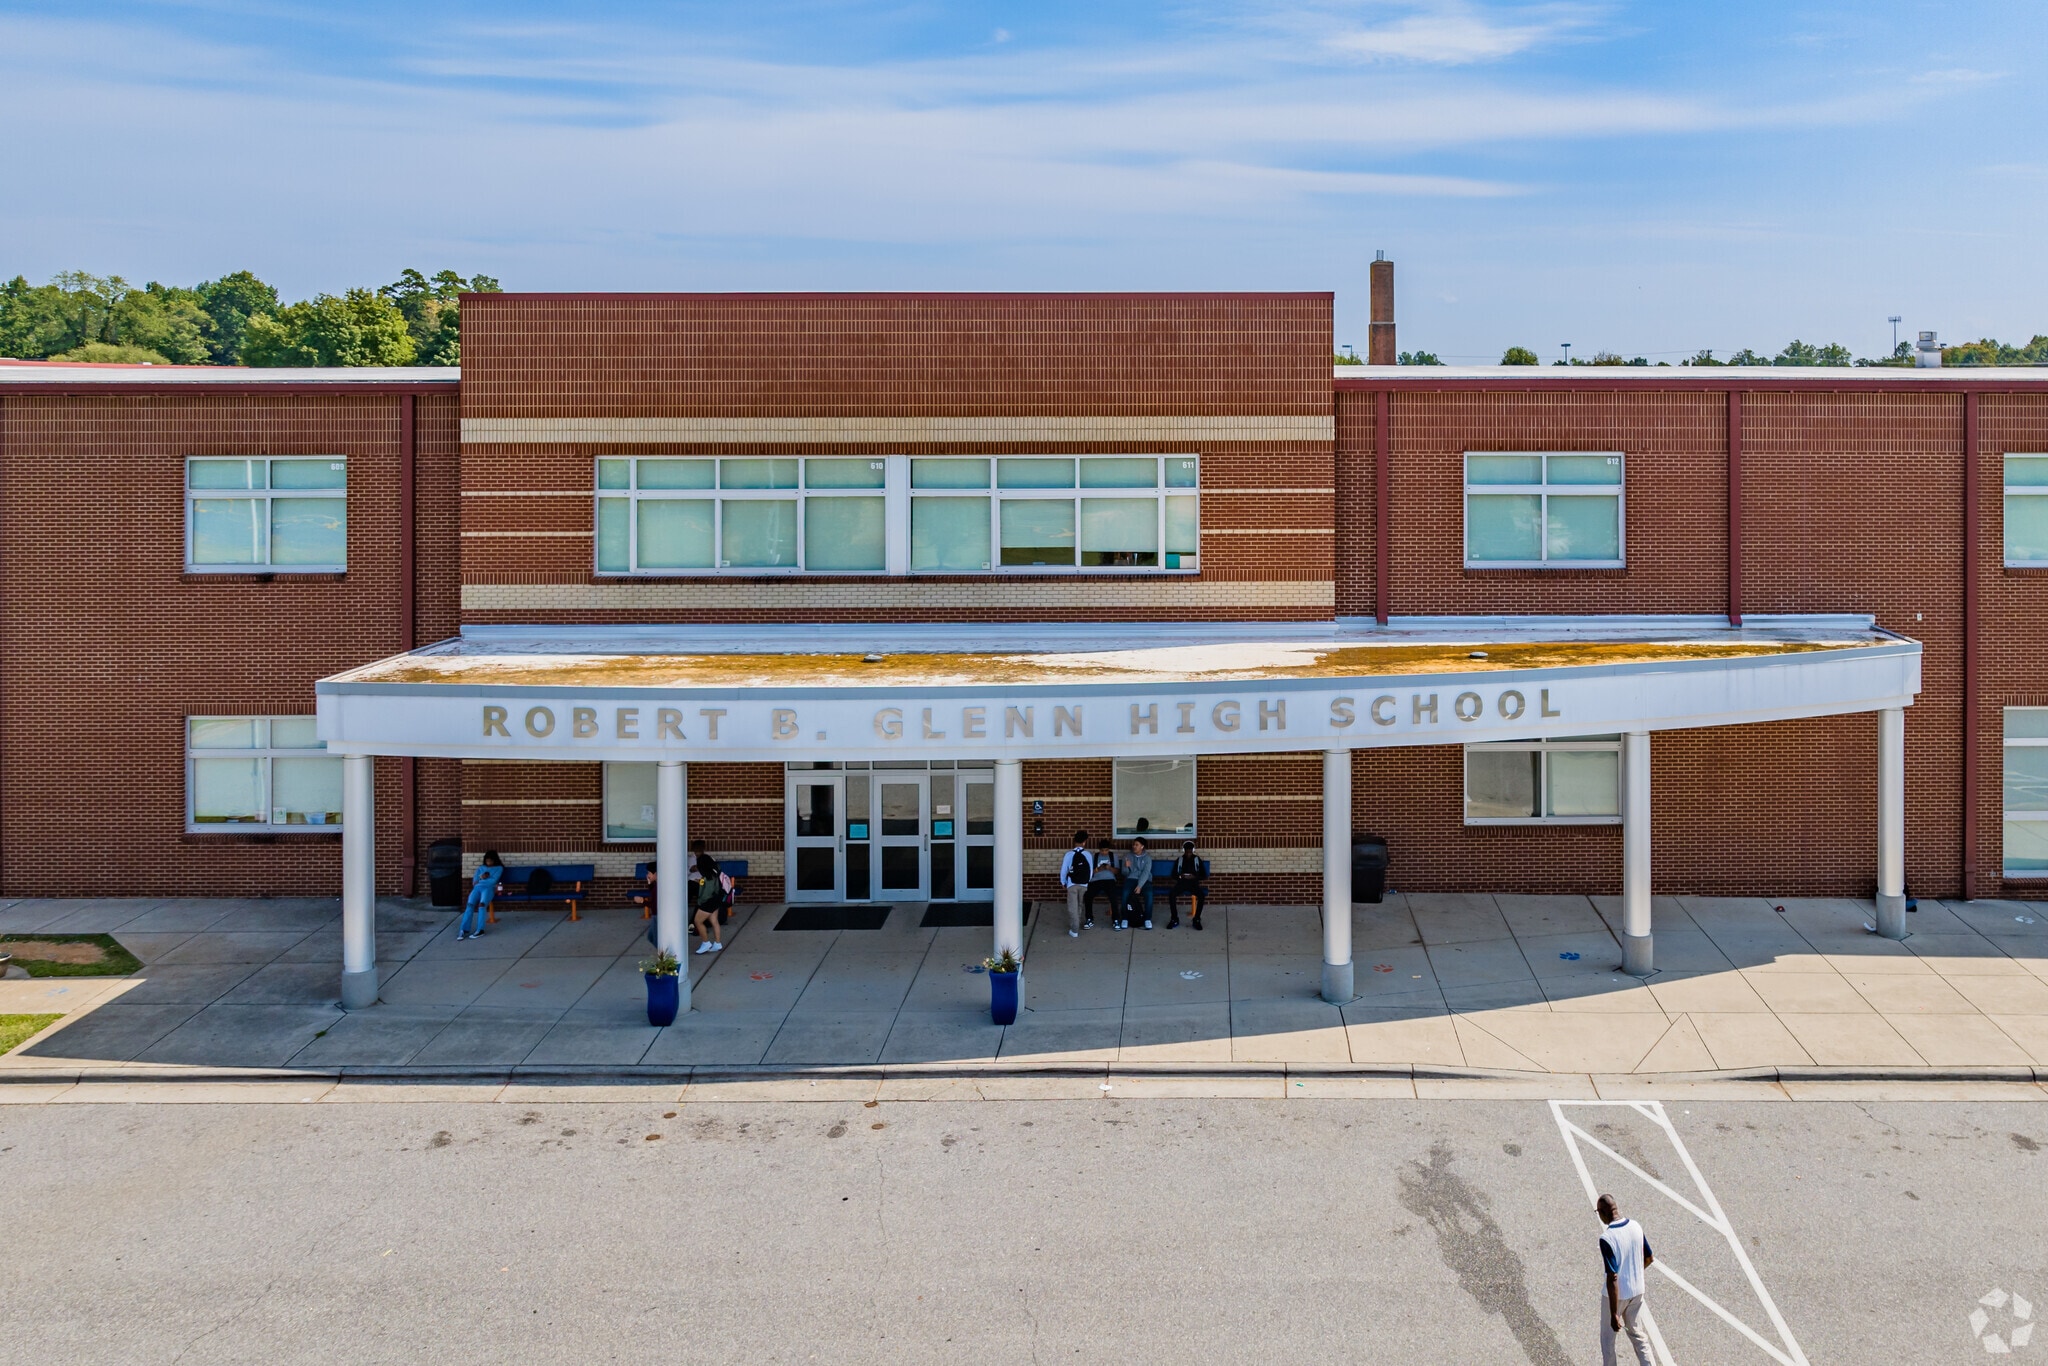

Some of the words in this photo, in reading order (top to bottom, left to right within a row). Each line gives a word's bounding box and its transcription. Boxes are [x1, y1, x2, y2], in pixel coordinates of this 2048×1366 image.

[482, 705, 727, 740] ROBERT
[772, 708, 827, 741] B.
[873, 705, 1084, 739] GLENN
[1130, 699, 1287, 735] HIGH
[1330, 689, 1561, 727] SCHOOL
